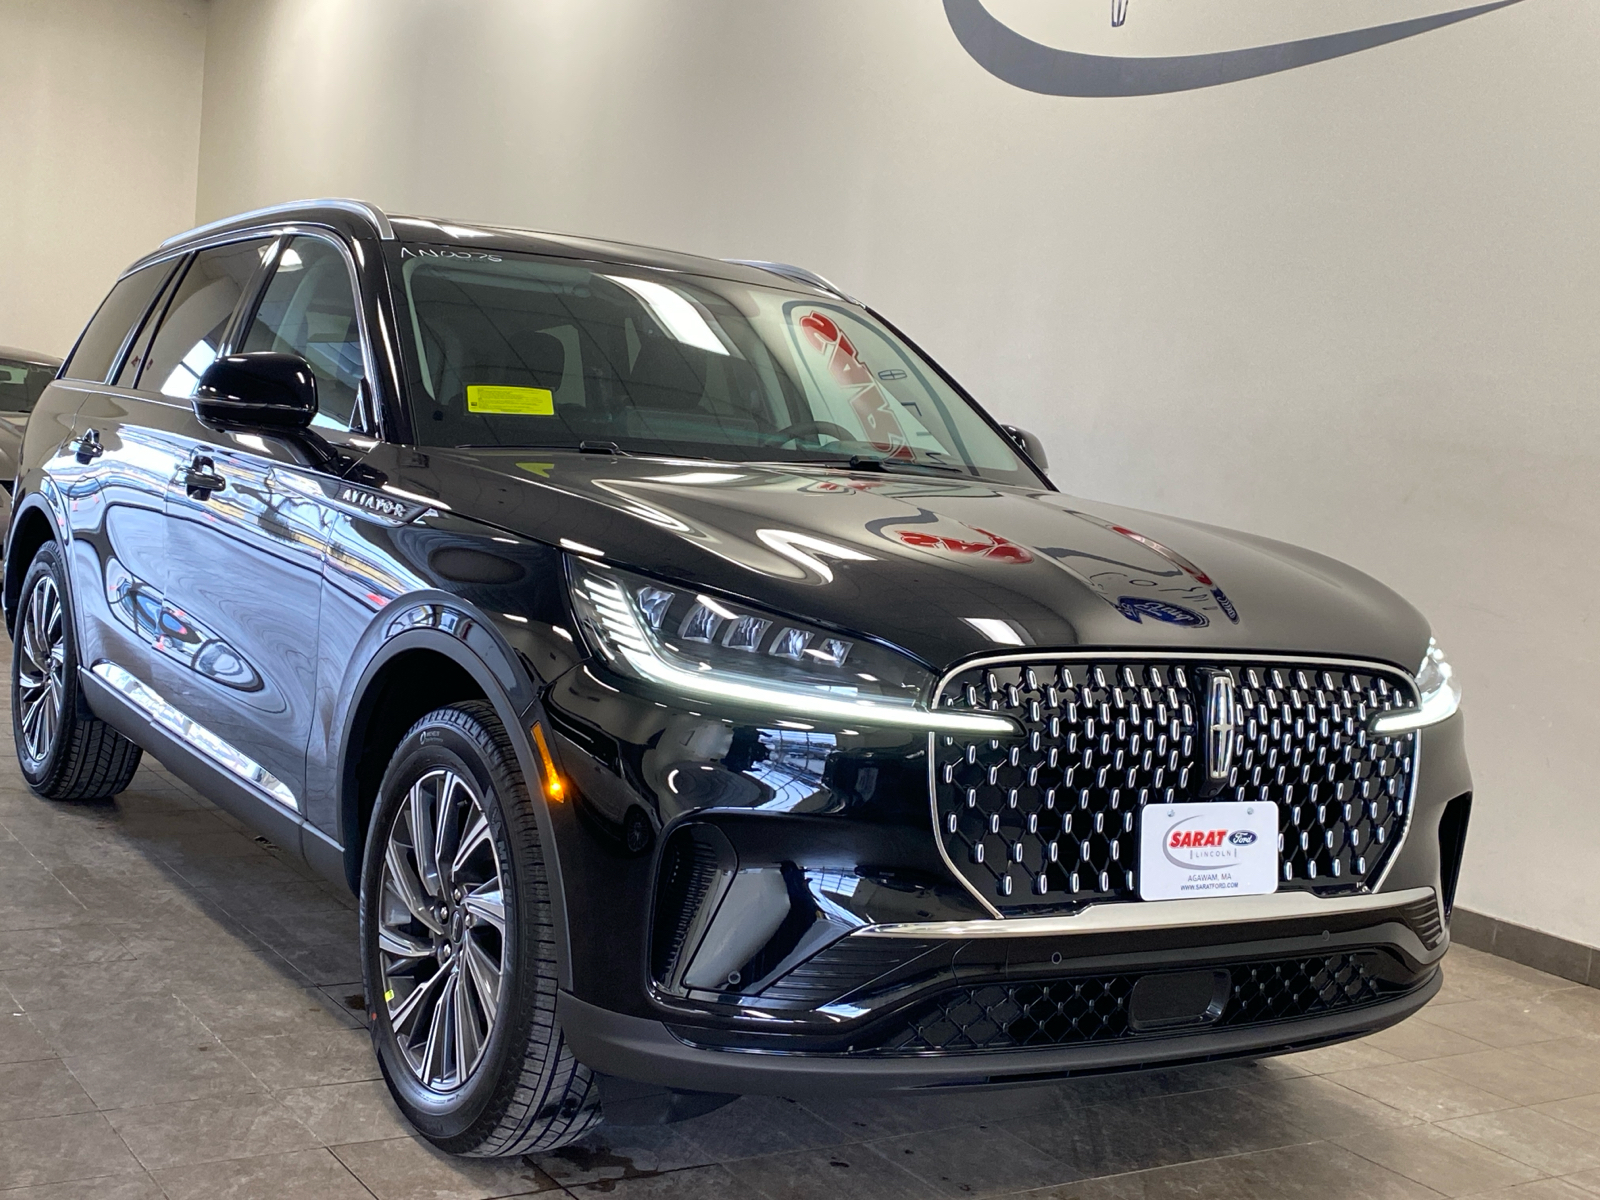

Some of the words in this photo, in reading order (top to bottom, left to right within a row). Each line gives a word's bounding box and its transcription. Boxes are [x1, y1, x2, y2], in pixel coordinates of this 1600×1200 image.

[343, 489, 406, 517] AVIATOR
[1169, 830, 1227, 849] SARAT
[1231, 831, 1254, 845] Ford
[1195, 850, 1231, 858] LINCOLN
[1188, 873, 1219, 882] AGAWAM,
[1221, 872, 1232, 880] MA
[1180, 881, 1239, 891] WWW.SARATFORD.COM
